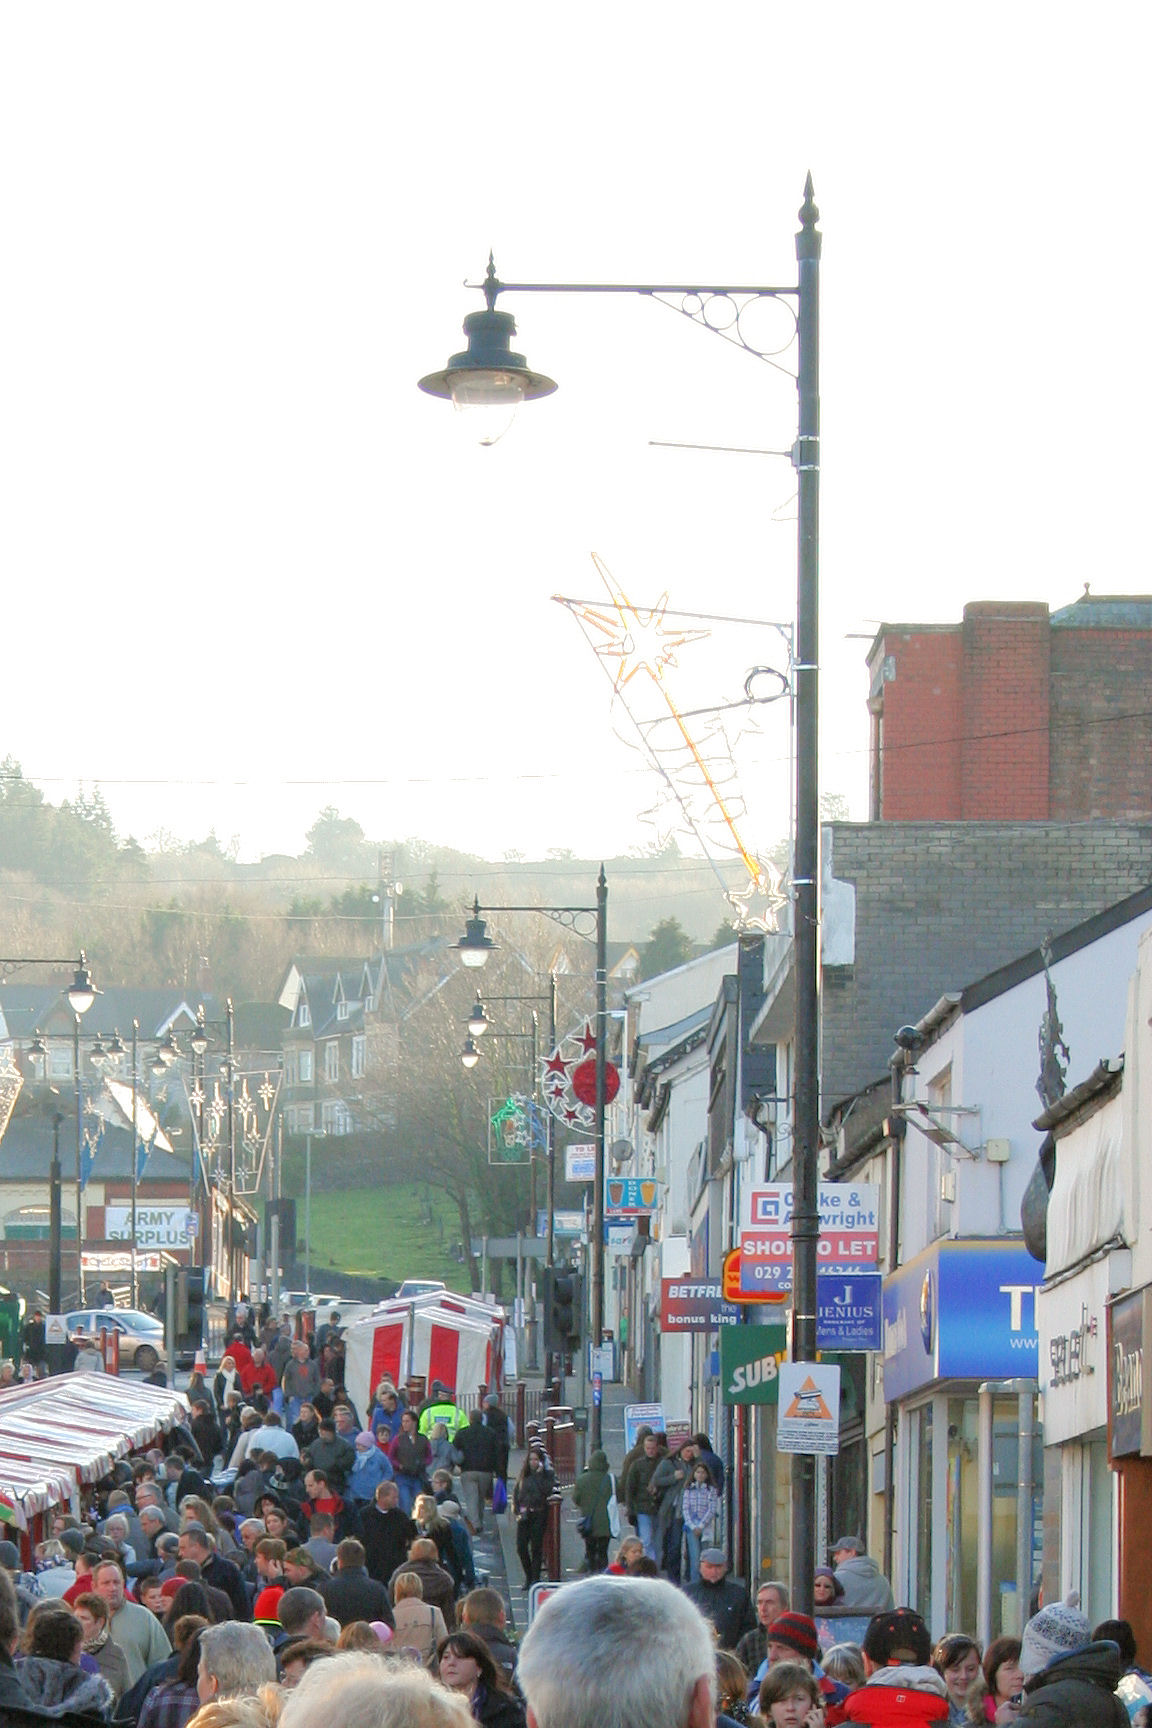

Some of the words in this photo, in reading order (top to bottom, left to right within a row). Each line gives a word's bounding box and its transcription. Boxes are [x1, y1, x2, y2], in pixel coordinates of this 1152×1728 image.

[784, 1192, 841, 1207] Cke
[848, 1192, 861, 1207] &
[124, 1211, 175, 1226] ARMY
[783, 1211, 875, 1229] Awright
[108, 1230, 189, 1245] SURPLUS
[838, 1240, 876, 1256] LET
[754, 1266, 781, 1279] 029
[668, 1285, 722, 1299] BETFR
[667, 1313, 706, 1324] bonus
[710, 1313, 737, 1325] king
